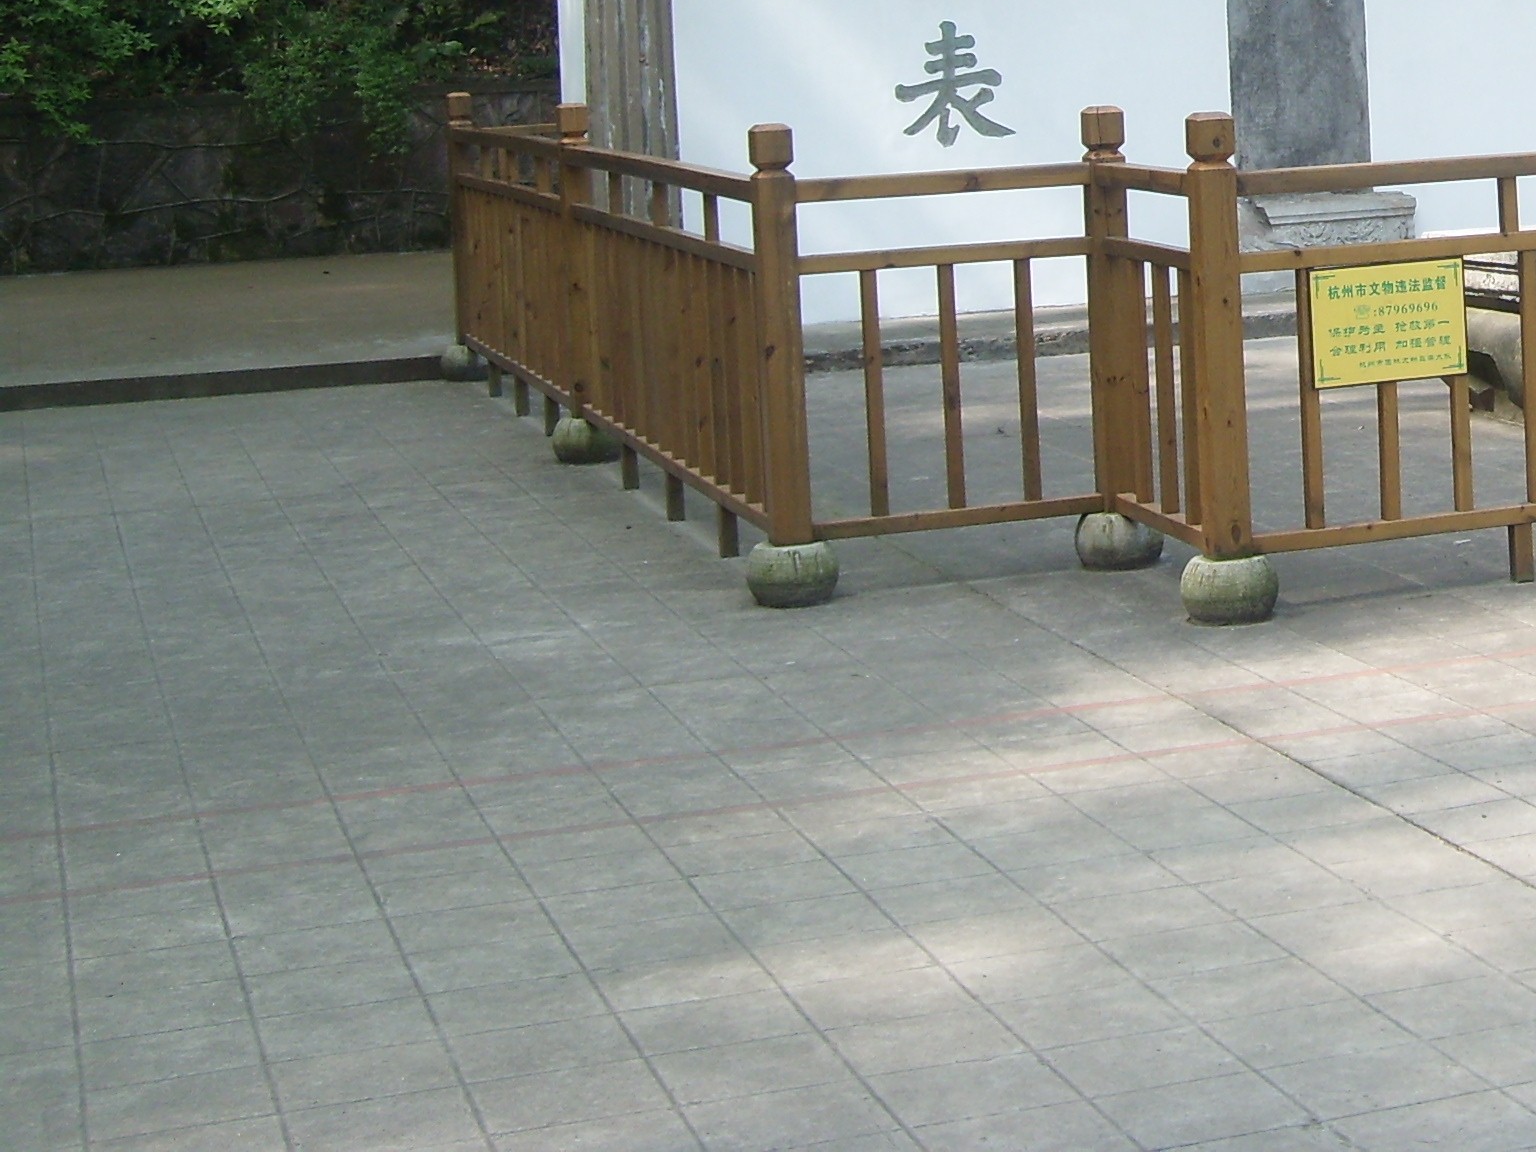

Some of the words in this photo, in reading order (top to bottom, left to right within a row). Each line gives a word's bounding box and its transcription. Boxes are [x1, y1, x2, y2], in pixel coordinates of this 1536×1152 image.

[1327, 275, 1447, 300] 杭州市文物违法监督
